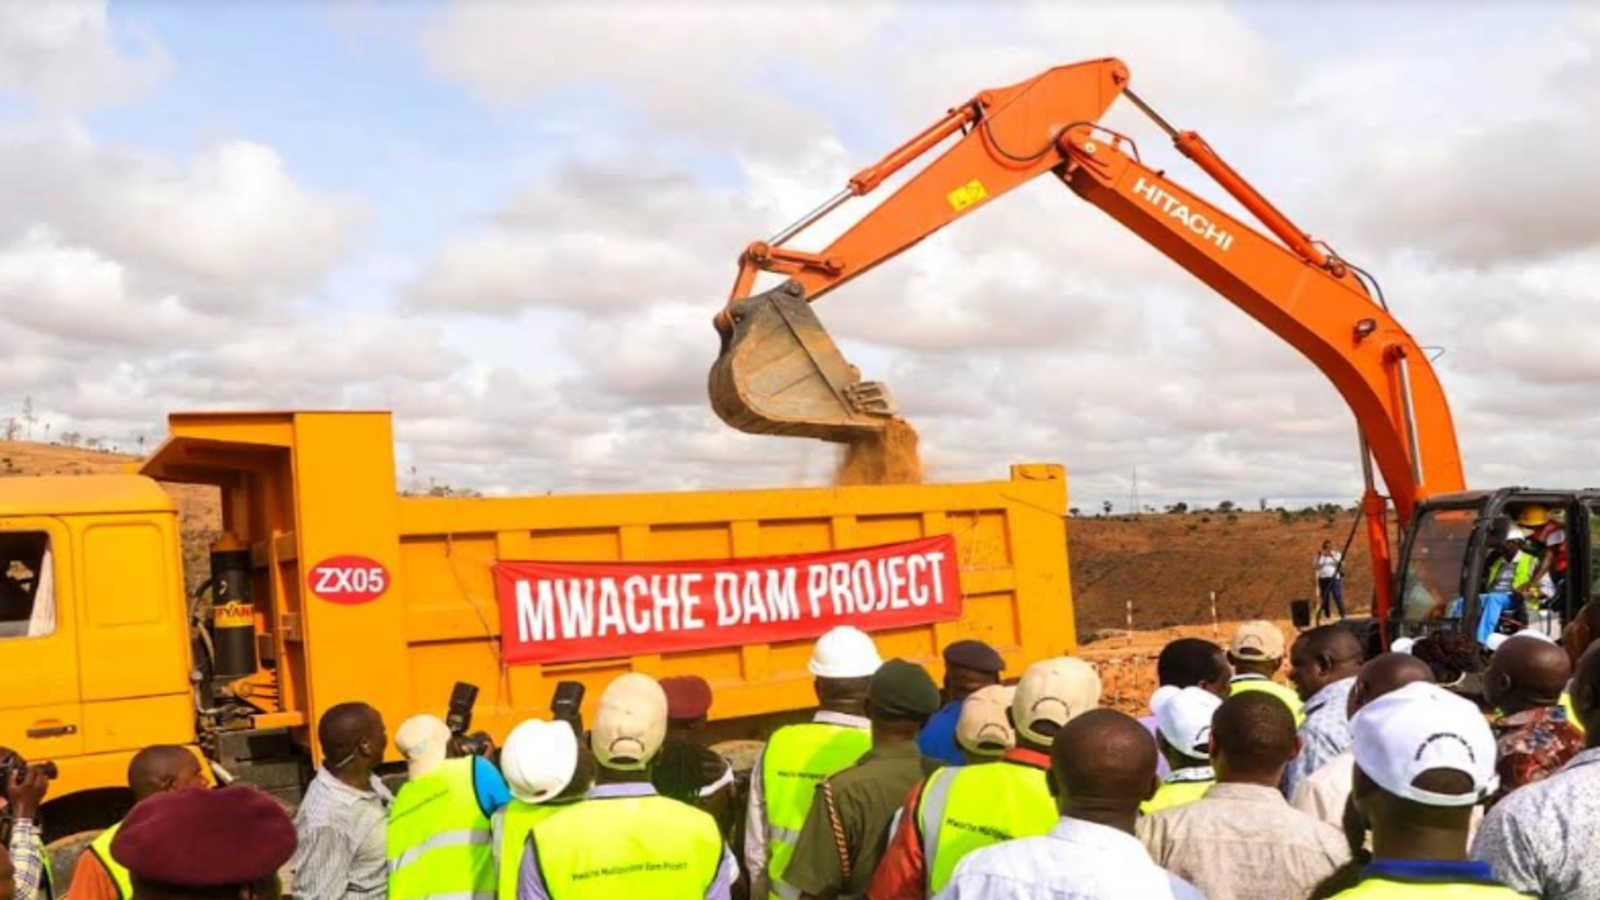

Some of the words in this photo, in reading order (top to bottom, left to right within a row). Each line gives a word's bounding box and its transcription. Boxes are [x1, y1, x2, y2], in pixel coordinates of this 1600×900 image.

[1132, 177, 1233, 251] HITACHI
[314, 567, 384, 593] ZX05
[514, 573, 704, 643] MWACHE
[715, 566, 800, 627] DAM
[806, 551, 945, 617] PROJECT
